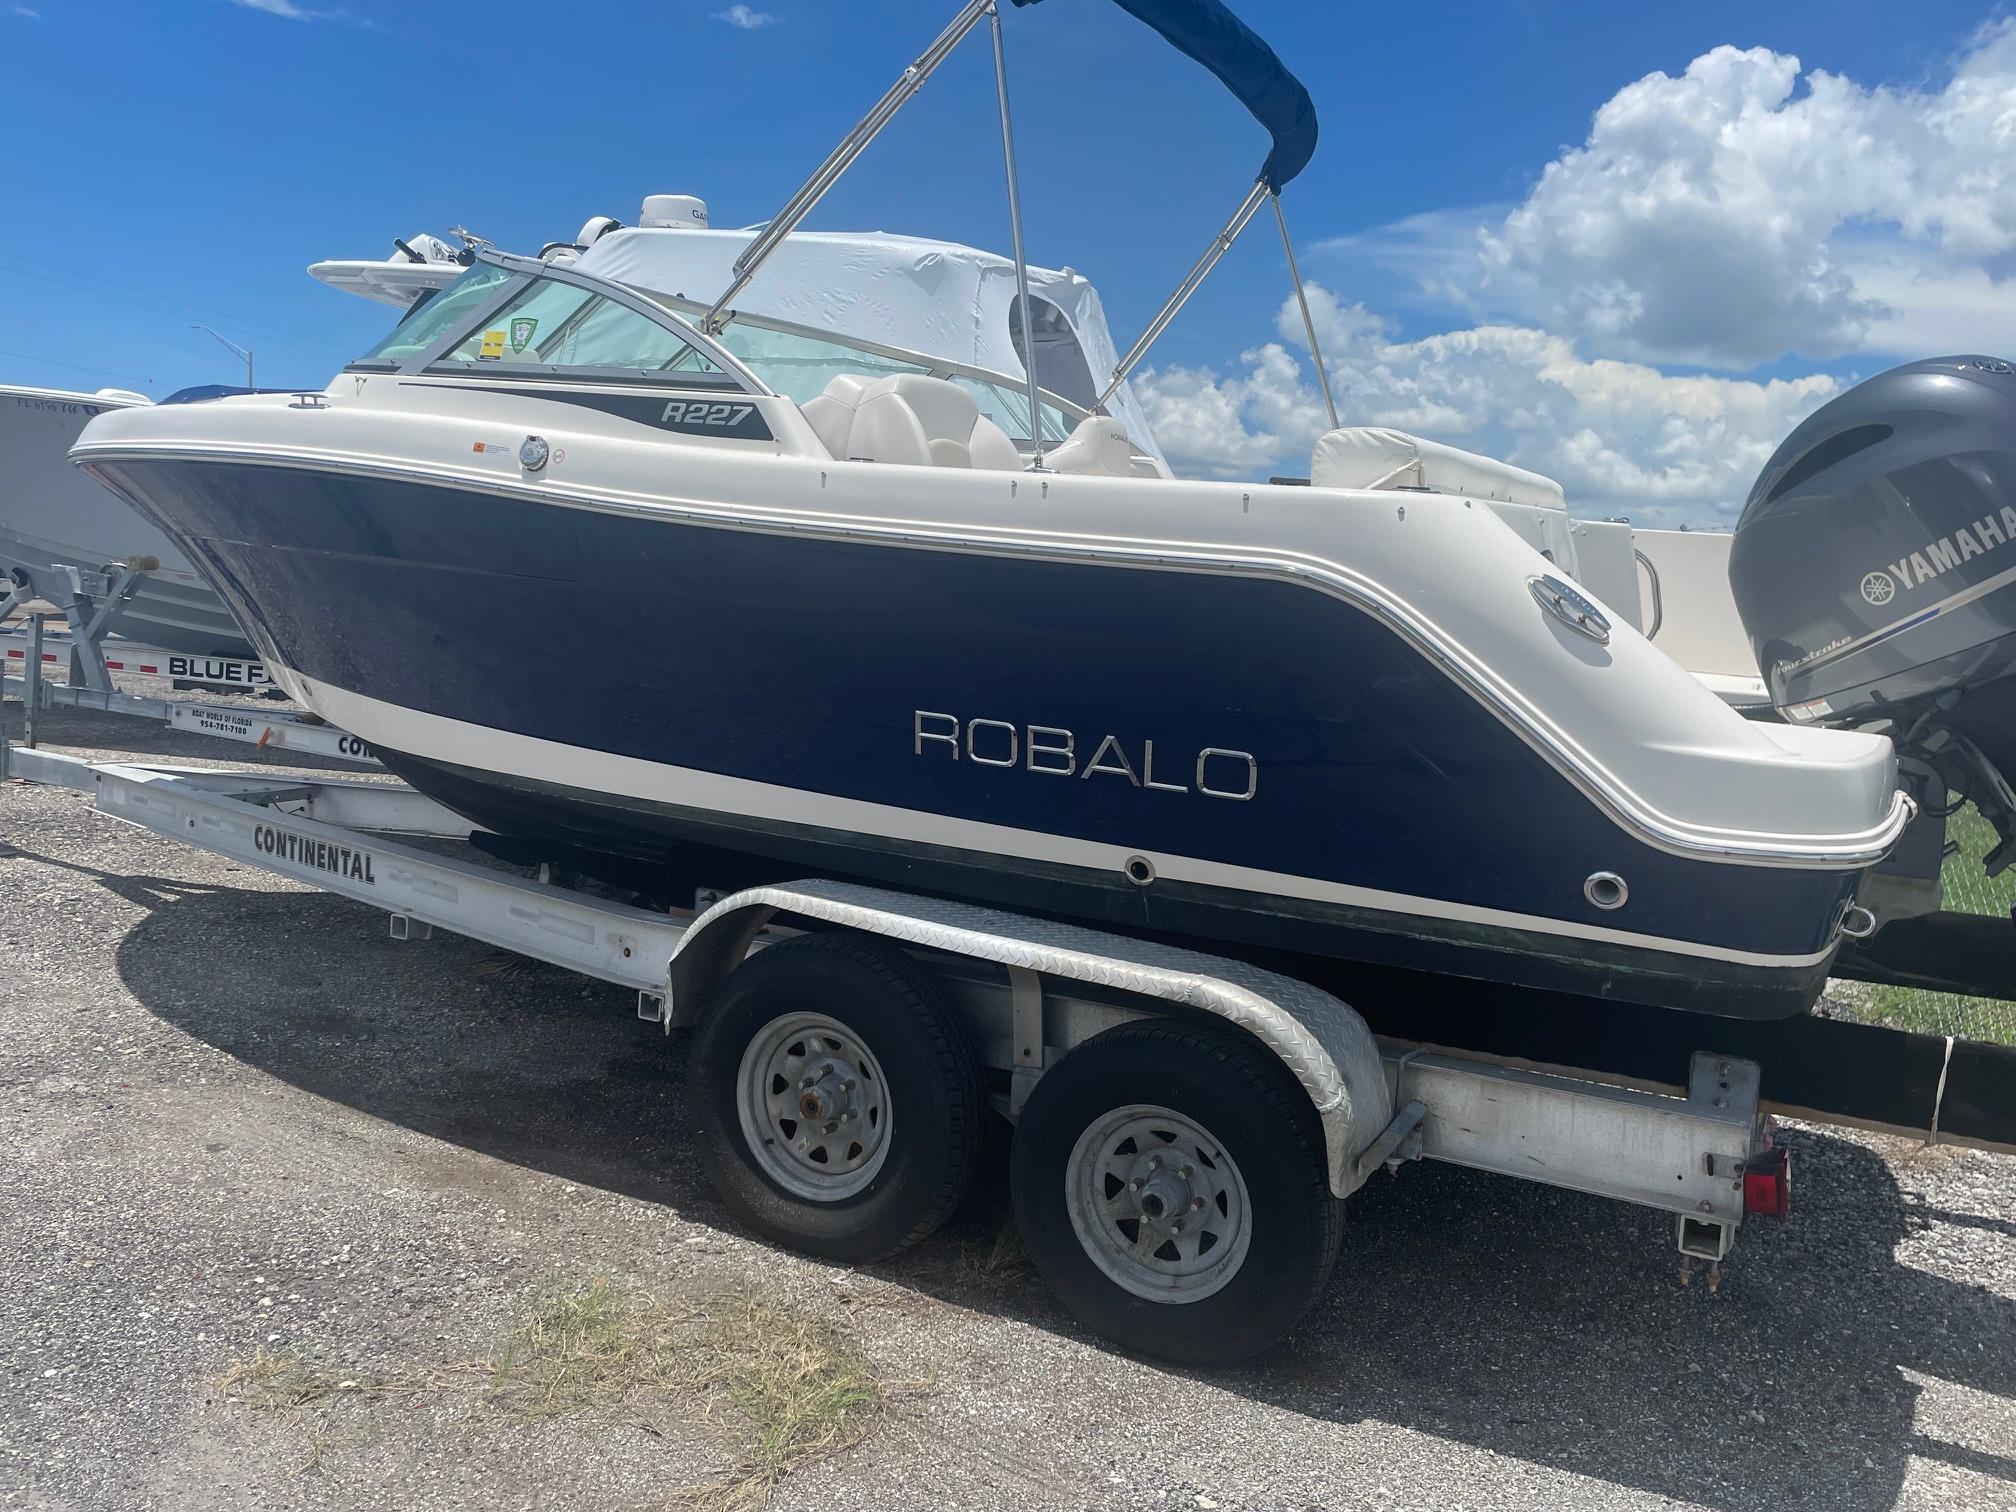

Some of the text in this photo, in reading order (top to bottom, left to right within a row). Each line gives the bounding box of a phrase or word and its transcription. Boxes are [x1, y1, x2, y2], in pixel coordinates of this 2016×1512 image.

[661, 402, 753, 426] R227
[1888, 506, 2016, 590] YAMAHA
[169, 657, 242, 682] BLUE
[192, 709, 253, 727] BOAT WORLD OF FLORIDA
[200, 719, 247, 735] 954-781-7100
[914, 709, 1259, 801] ROBALO
[254, 824, 376, 886] CONTINENTAL
